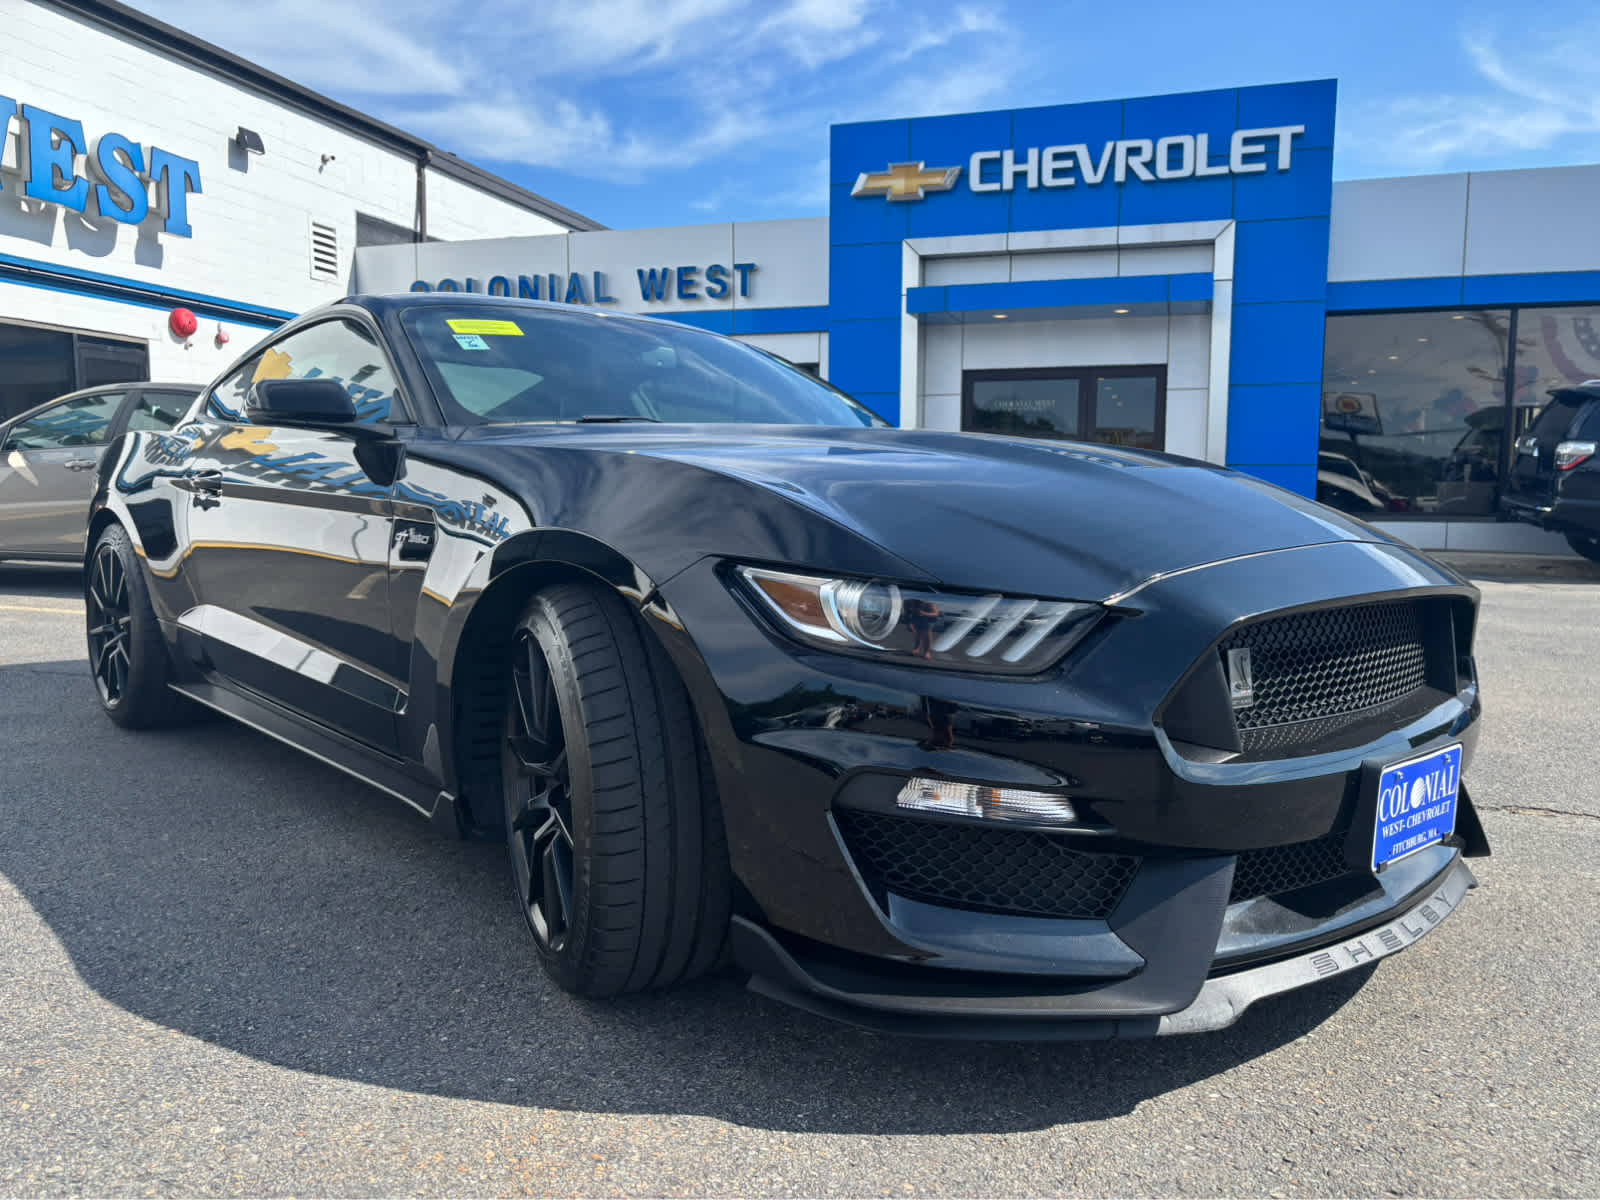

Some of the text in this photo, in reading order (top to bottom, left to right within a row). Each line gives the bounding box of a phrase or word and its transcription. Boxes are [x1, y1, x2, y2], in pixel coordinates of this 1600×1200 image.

[968, 124, 1305, 194] CHEVROLET
[637, 263, 756, 302] WEST
[1379, 765, 1456, 823] COLONIAL
[1310, 889, 1453, 976] SHELBY
